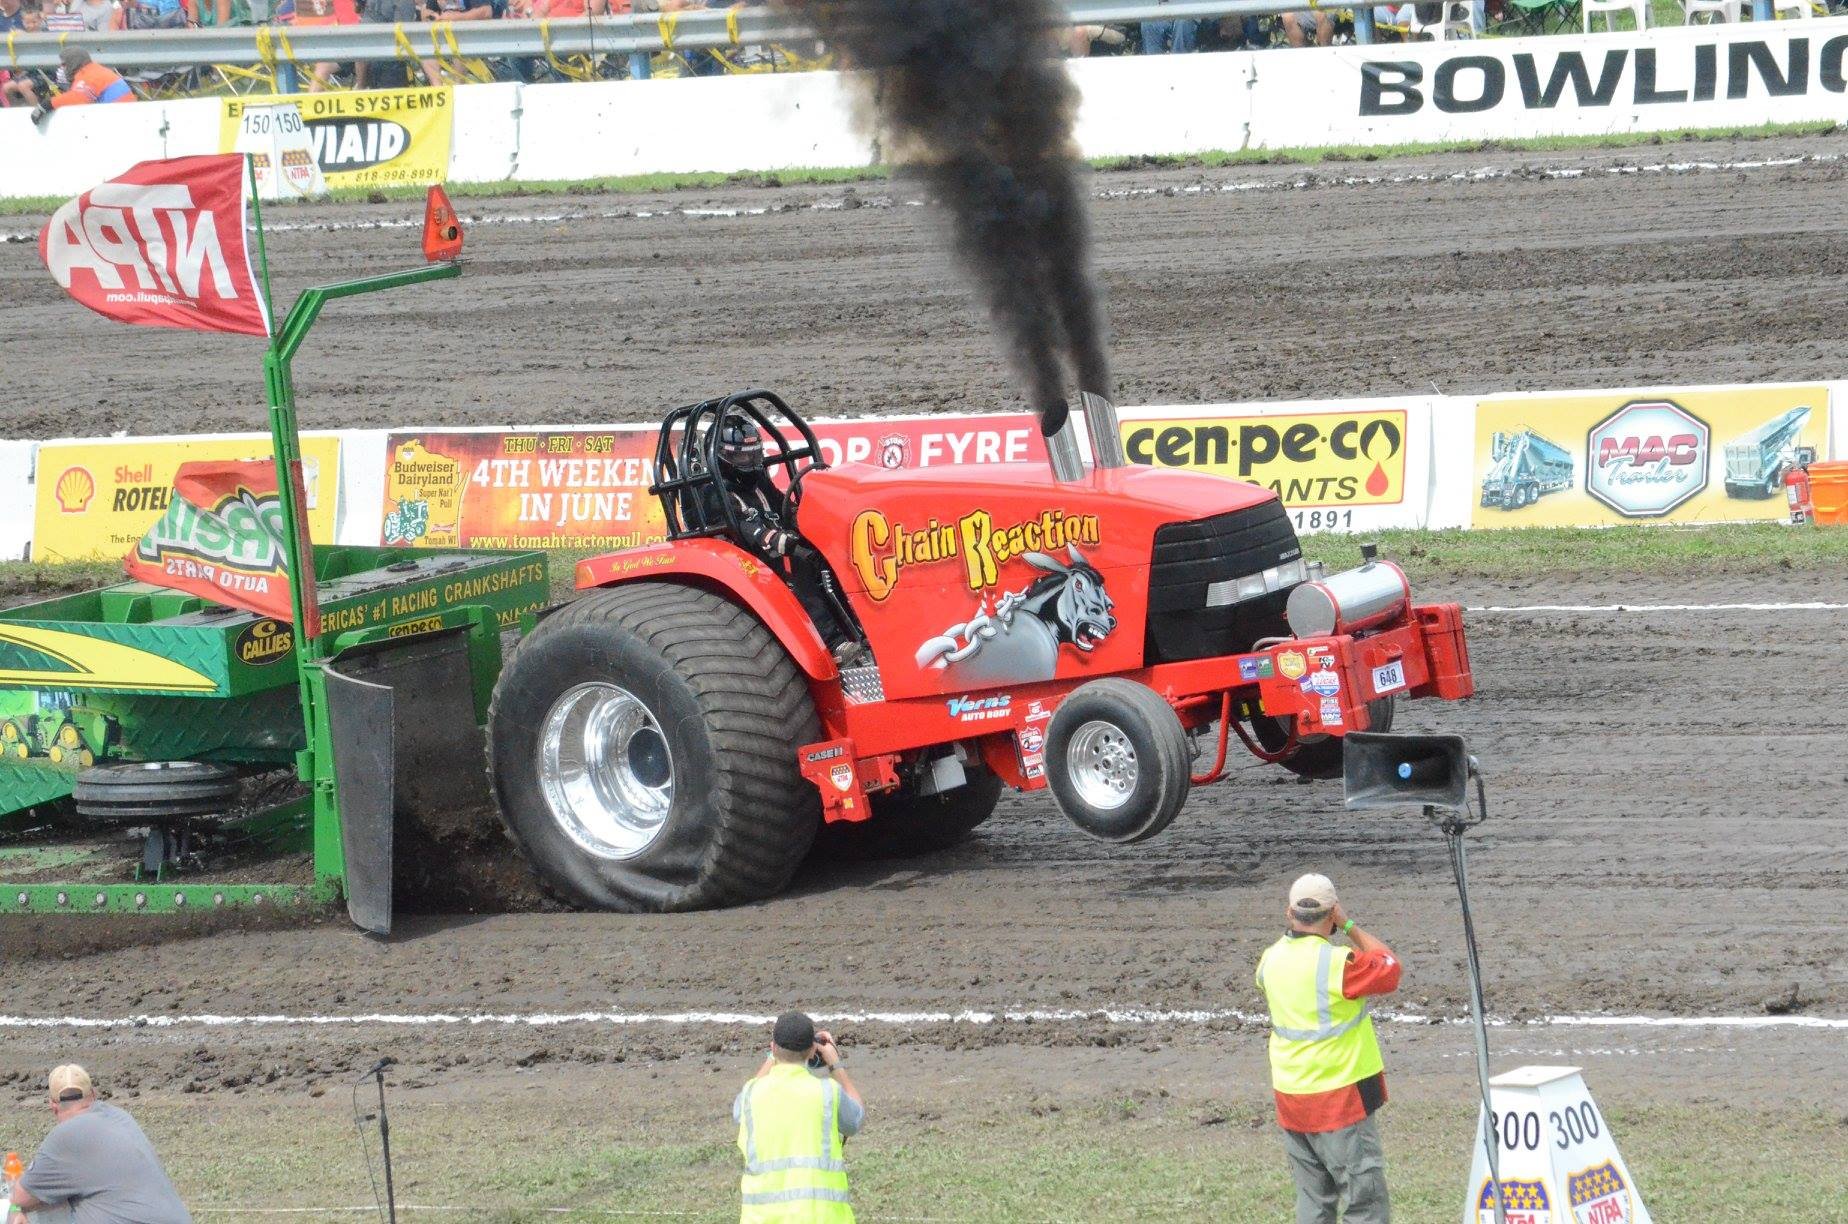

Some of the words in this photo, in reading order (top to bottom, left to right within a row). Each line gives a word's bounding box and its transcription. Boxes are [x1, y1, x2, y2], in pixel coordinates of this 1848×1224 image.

[313, 98, 345, 115] OIL
[355, 91, 446, 112] SYSTEMS
[244, 114, 270, 134] 150
[275, 112, 301, 133] 150
[303, 122, 405, 164] VIAID
[504, 436, 537, 453] THU
[548, 436, 573, 453] FRI
[585, 435, 614, 453] SAT
[919, 430, 1028, 468] FYRE
[1599, 433, 1698, 468] MAC
[115, 464, 152, 483] Shell
[395, 461, 454, 473] Budweiser
[471, 459, 531, 488] 4TH
[538, 458, 668, 488] WEEKEN
[1605, 457, 1688, 486] Trailer
[398, 473, 453, 487] Dairyland
[113, 487, 174, 511] ROTEL
[419, 489, 437, 499] Super
[440, 500, 453, 508] Pull
[518, 493, 544, 521] IN
[556, 493, 633, 527] JUNE
[425, 535, 446, 545] Tomah
[447, 535, 456, 545] WI
[959, 509, 1099, 589] Reaction
[852, 510, 957, 601] Chain
[320, 606, 368, 634] ERICAS'
[372, 600, 387, 622] #1
[392, 588, 438, 616] RACING
[445, 563, 543, 602] CRANKSHAFTS
[243, 632, 291, 660] CALLIES
[1379, 669, 1397, 686] 648
[961, 711, 985, 721] AUTO
[986, 708, 1011, 719] BODY
[807, 748, 834, 761] CASE
[1550, 1100, 1599, 1150] 300
